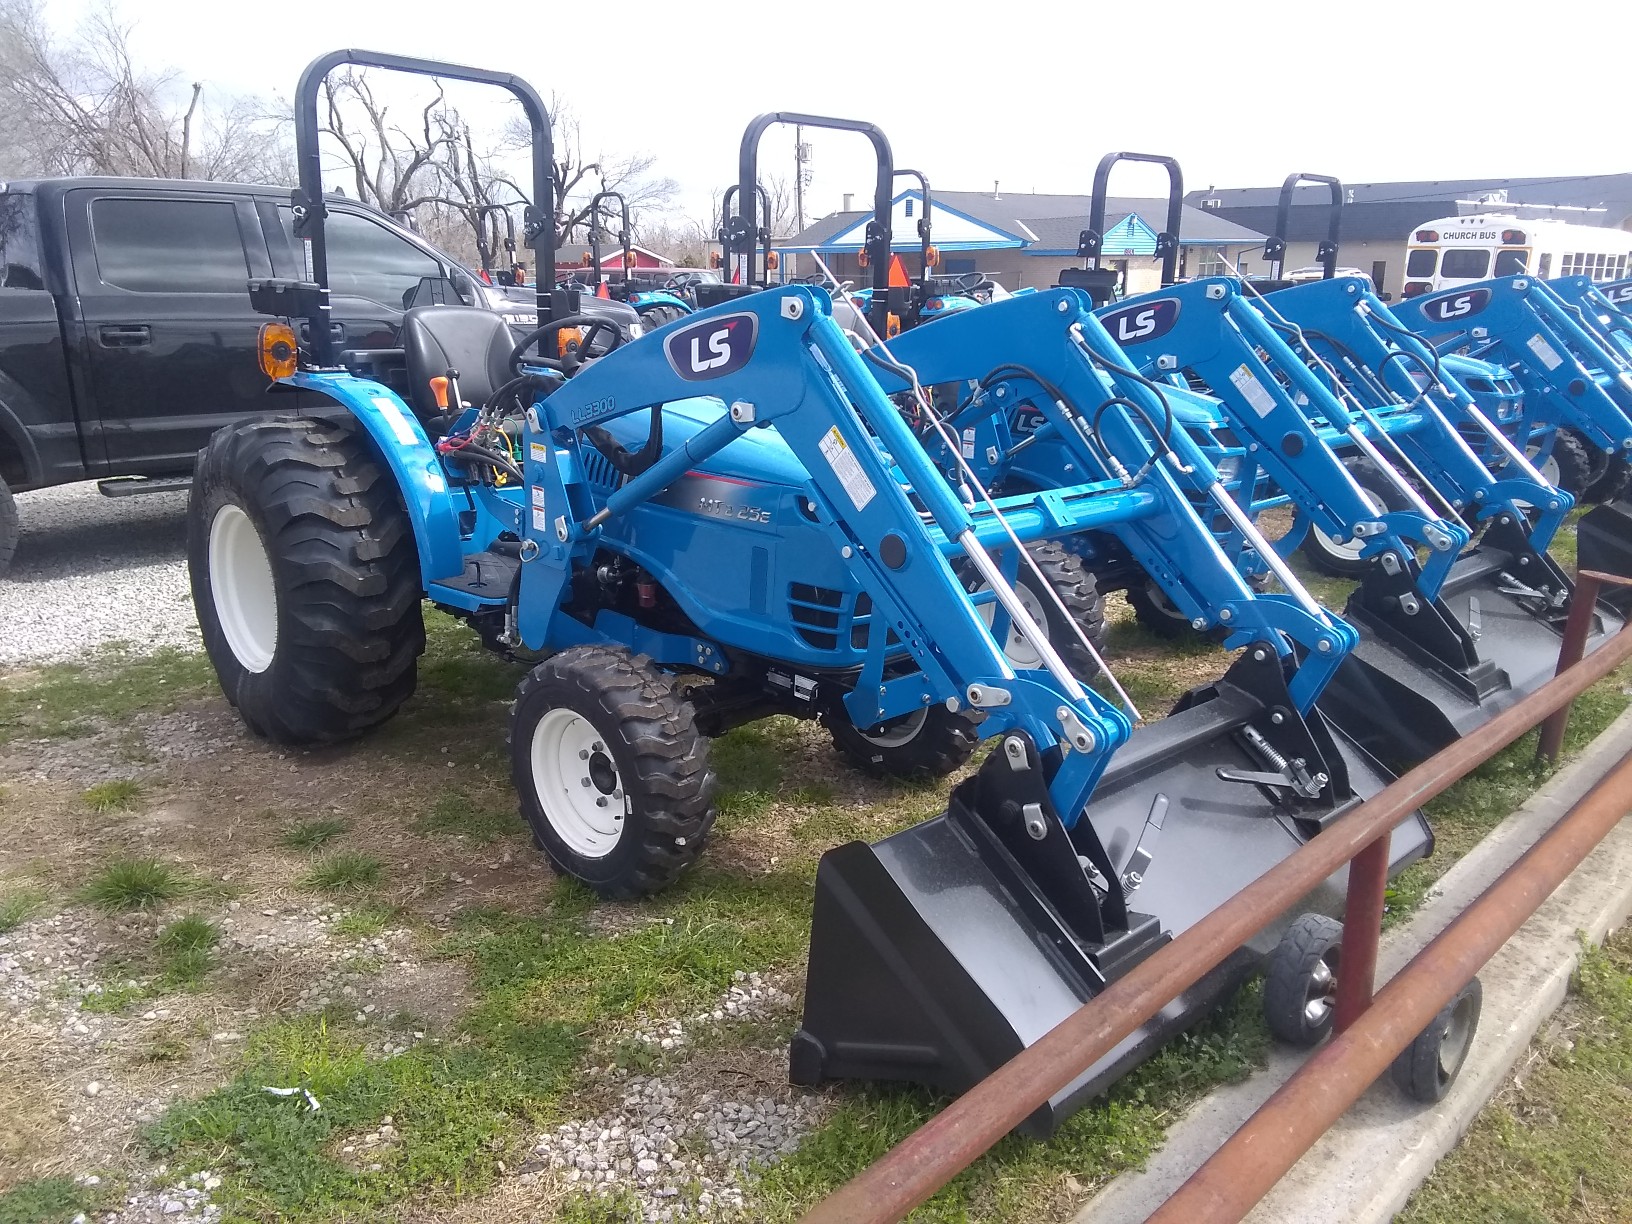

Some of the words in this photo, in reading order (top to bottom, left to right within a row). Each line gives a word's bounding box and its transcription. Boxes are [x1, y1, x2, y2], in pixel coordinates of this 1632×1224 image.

[1443, 231, 1477, 240] CHURCH
[1479, 231, 1497, 240] BUS
[1440, 296, 1471, 319] LS
[1118, 309, 1156, 341] LS
[691, 328, 731, 373] LS
[571, 395, 615, 424] LL3300
[1016, 414, 1045, 432] LS
